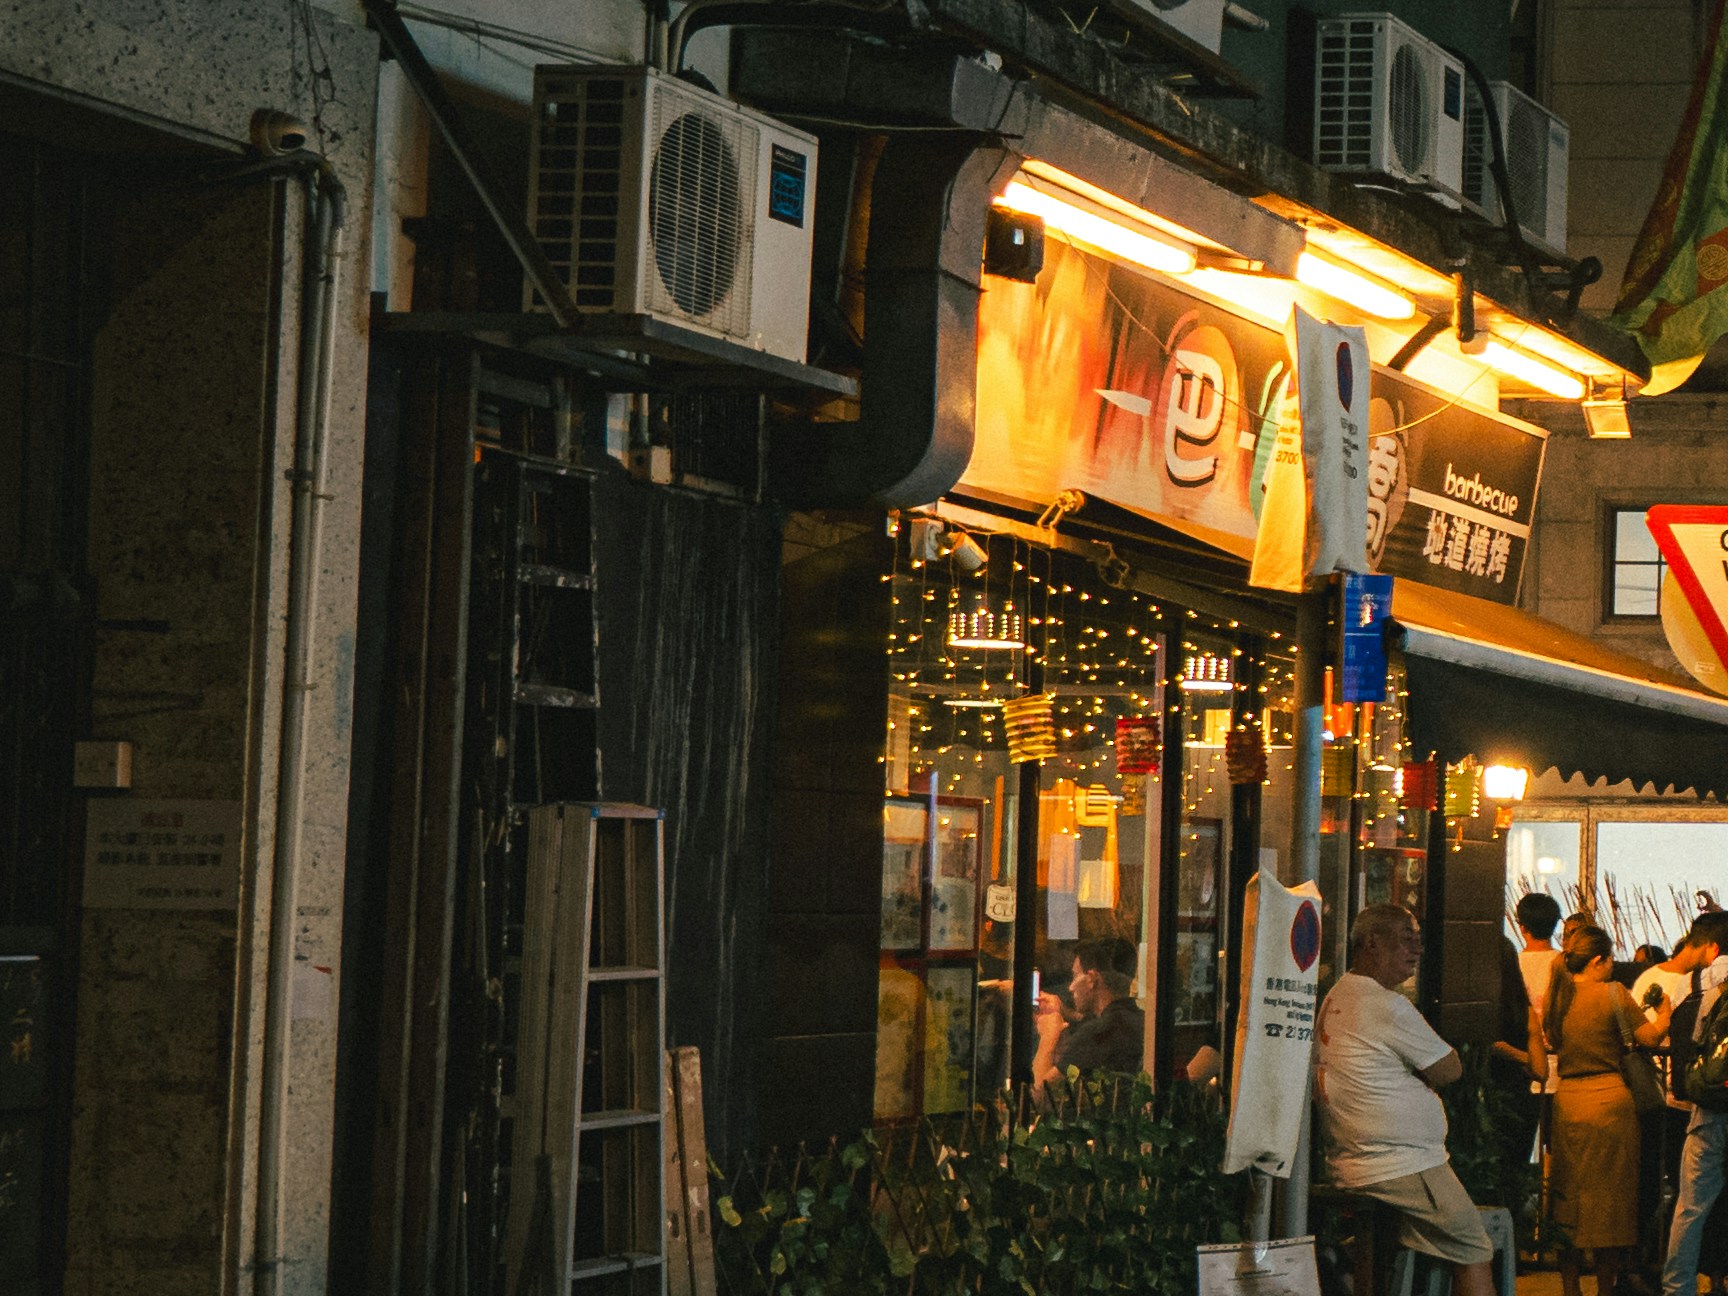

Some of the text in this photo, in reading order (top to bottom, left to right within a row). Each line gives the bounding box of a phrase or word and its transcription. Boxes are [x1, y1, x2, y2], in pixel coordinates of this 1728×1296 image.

[1444, 462, 1519, 517] barbecue
[1423, 509, 1511, 584] 地道燒烤
